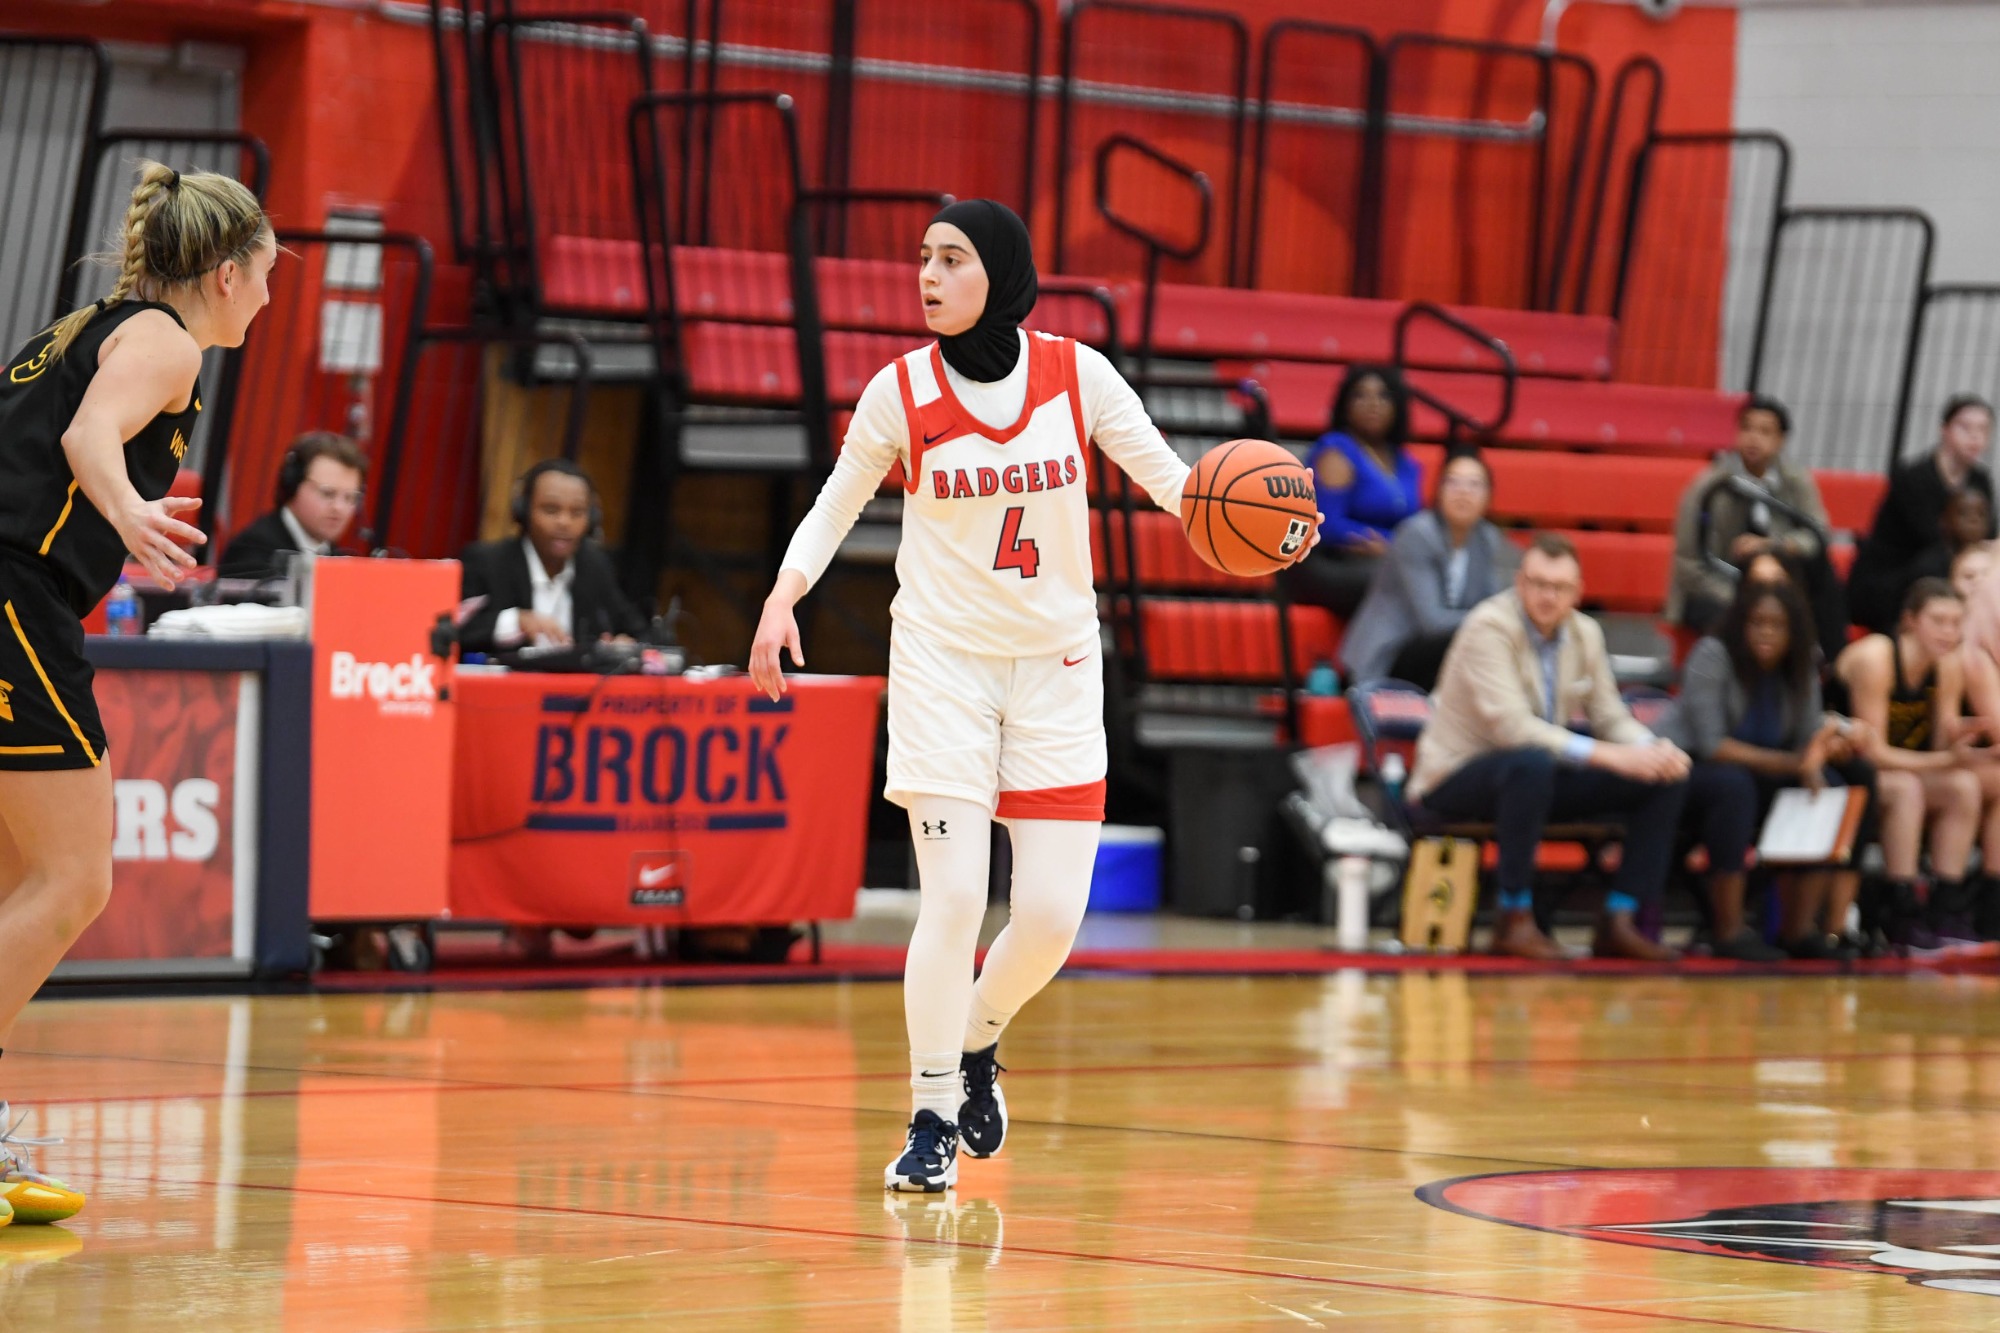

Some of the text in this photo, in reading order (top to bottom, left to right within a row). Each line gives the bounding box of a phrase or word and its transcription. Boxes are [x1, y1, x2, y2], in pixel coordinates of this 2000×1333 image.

[931, 455, 1077, 499] BADGERS
[992, 506, 1040, 578] 4
[331, 650, 435, 698] Brock
[532, 725, 790, 804] BROCK
